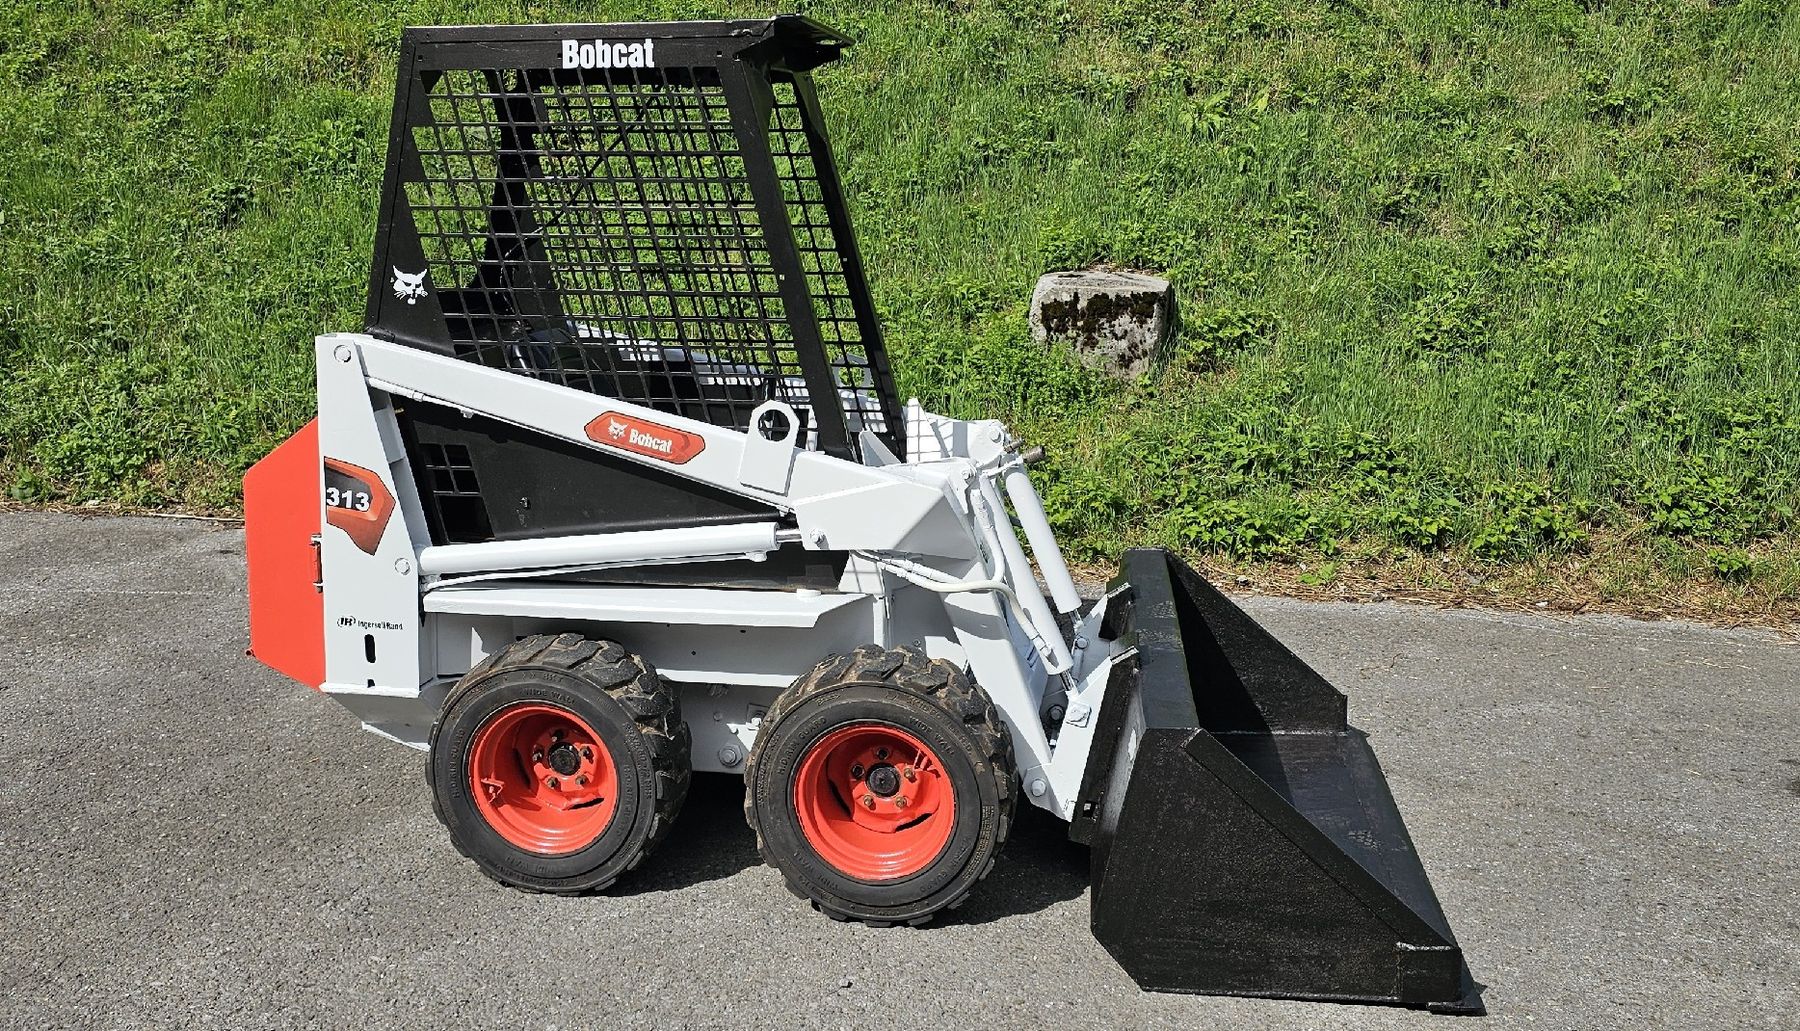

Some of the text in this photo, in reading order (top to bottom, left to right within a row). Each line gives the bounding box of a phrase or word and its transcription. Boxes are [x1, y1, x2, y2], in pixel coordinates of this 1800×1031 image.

[562, 38, 655, 69] Bobcat
[629, 428, 673, 453] Bobcat
[326, 487, 370, 511] 313
